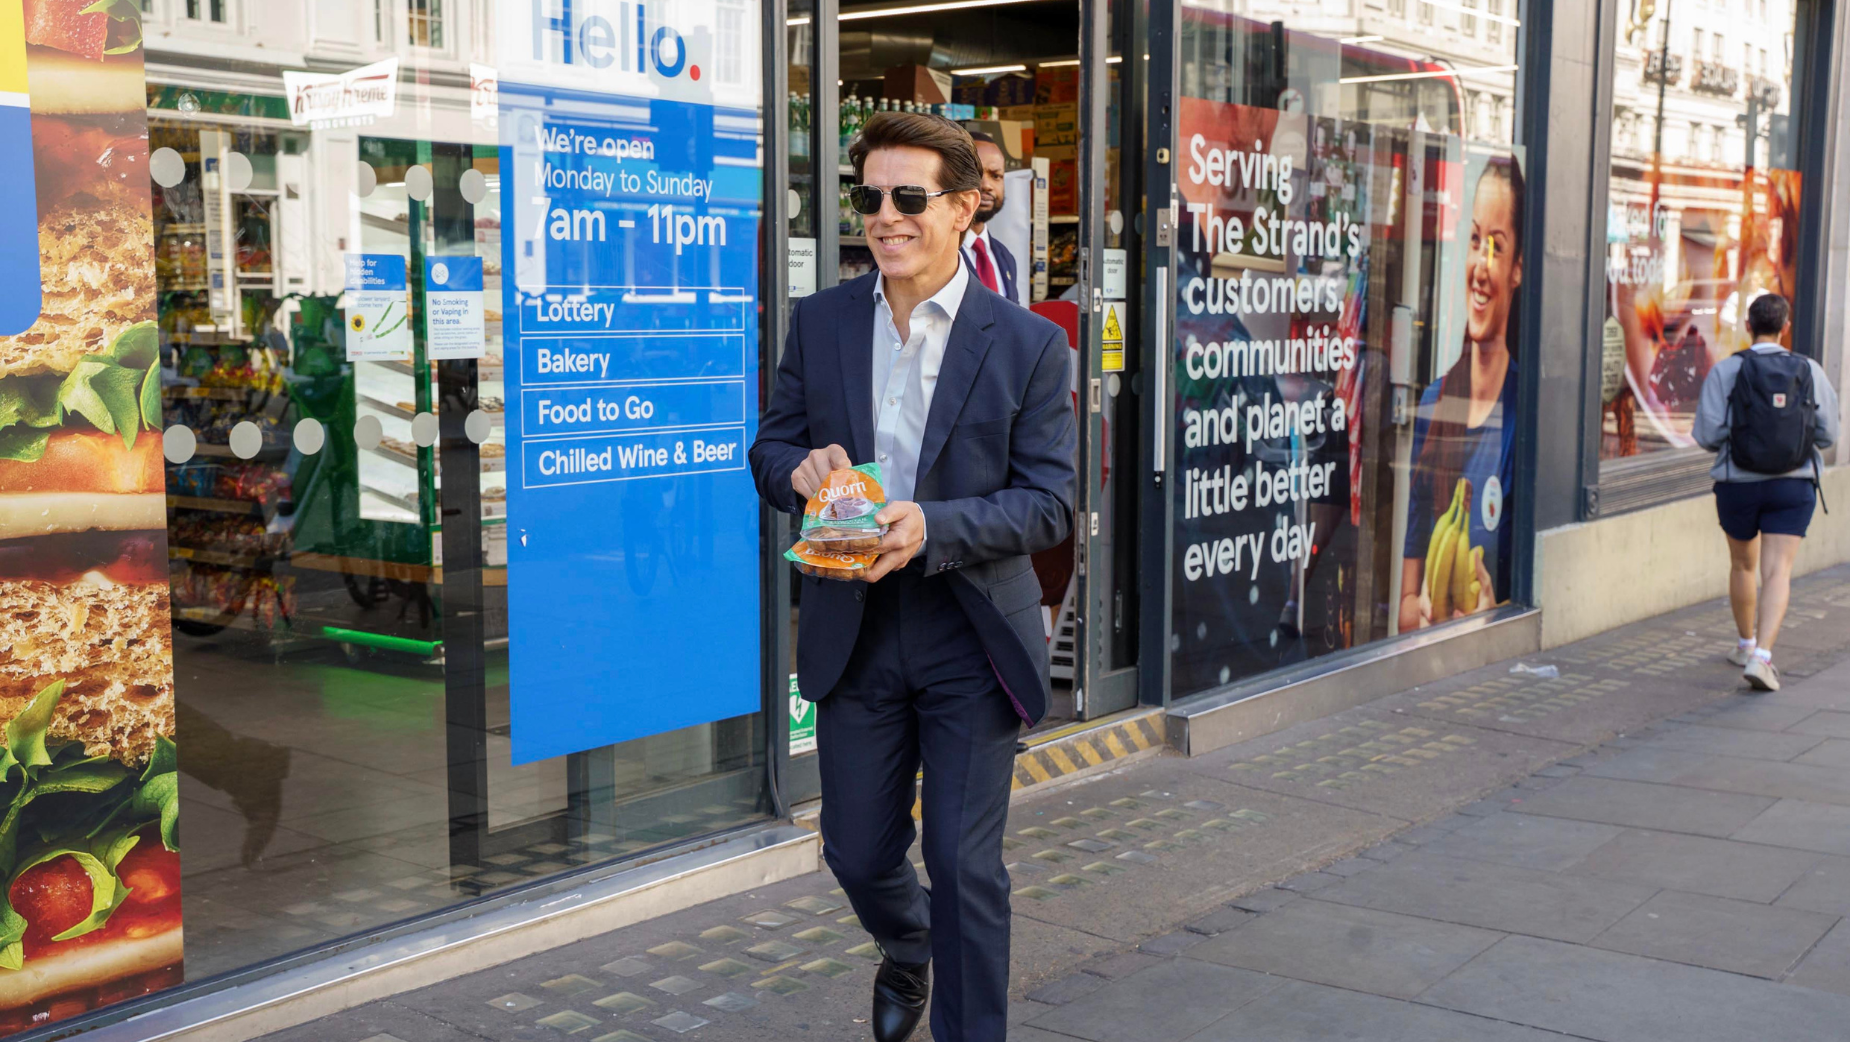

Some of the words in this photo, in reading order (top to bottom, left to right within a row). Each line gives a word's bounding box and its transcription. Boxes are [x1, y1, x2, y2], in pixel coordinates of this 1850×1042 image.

[532, 0, 701, 81] Hello.
[534, 125, 597, 154] We're
[603, 138, 655, 164] open
[534, 162, 615, 197] Monday
[620, 173, 641, 194] to
[646, 170, 713, 204] Sunday
[1188, 133, 1293, 205] Serving
[532, 197, 606, 242] 7am
[647, 203, 727, 256] 11pm
[1187, 203, 1244, 254] The
[1252, 206, 1360, 258] Strand's
[366, 259, 378, 267] for
[788, 249, 813, 257] tomatic
[788, 260, 804, 268] door
[441, 308, 462, 317] Vaping
[463, 307, 469, 315] in
[442, 298, 469, 307] Smoking
[536, 297, 615, 328] Lottery
[1187, 268, 1345, 321] customers,
[537, 348, 611, 378] Bakery
[1186, 325, 1355, 381] communities
[538, 398, 592, 425] Food
[597, 399, 619, 422] to
[625, 396, 655, 420] Go
[1185, 395, 1238, 449] and
[1246, 391, 1326, 455] planet
[1331, 397, 1346, 432] a
[538, 446, 612, 476] Chilled
[618, 444, 668, 469] Wine
[674, 441, 687, 465] &
[693, 440, 737, 463] Beer
[818, 481, 867, 503] Quorn
[1185, 465, 1248, 519] little
[1255, 456, 1337, 508] better
[1184, 530, 1265, 582] every
[1270, 515, 1318, 570] day.
